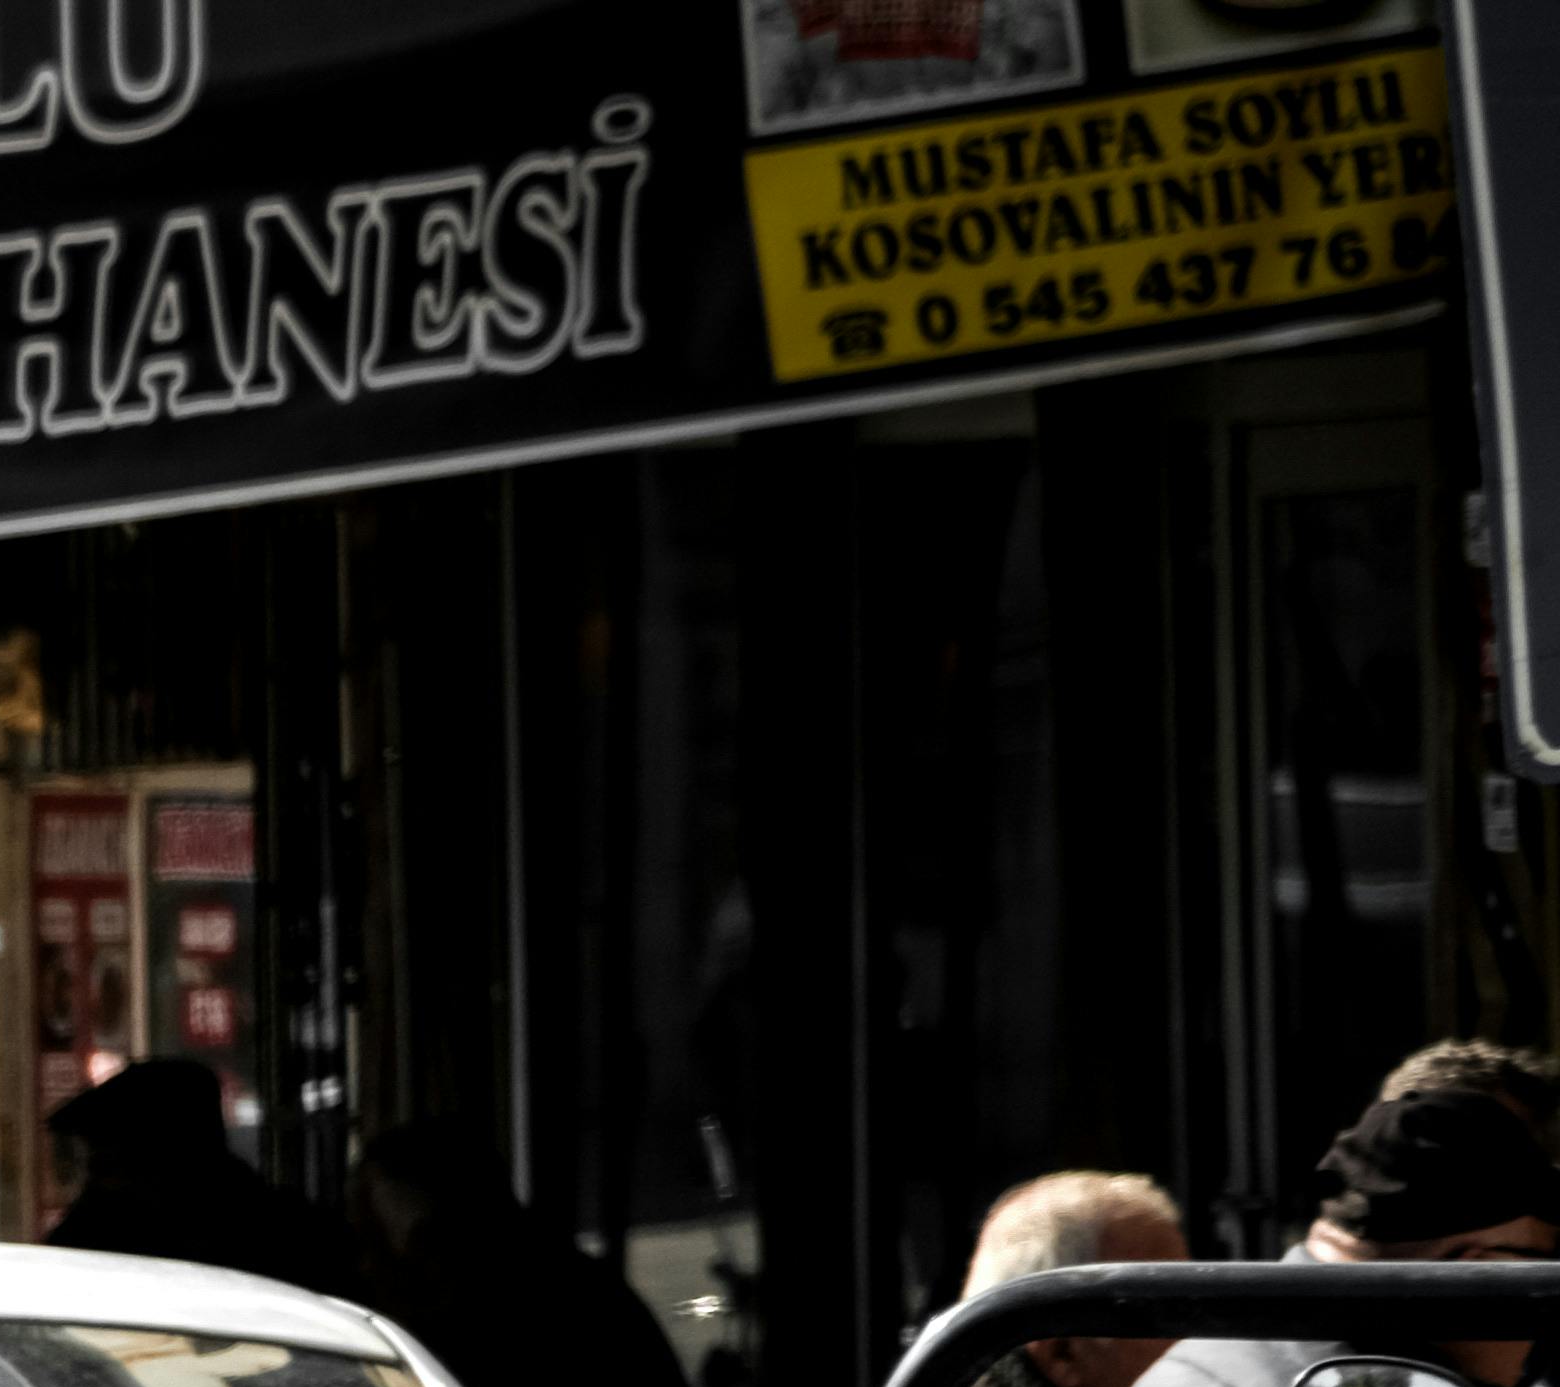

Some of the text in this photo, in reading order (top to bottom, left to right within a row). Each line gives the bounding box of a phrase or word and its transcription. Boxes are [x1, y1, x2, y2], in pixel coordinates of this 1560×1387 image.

[840, 68, 1407, 210] MUSTAFA SOYLU
[800, 155, 1286, 292] KOSOVALININ
[916, 291, 958, 347] 0
[981, 268, 1111, 338] 545
[1135, 243, 1256, 310] 437
[1278, 228, 1370, 290] 76
